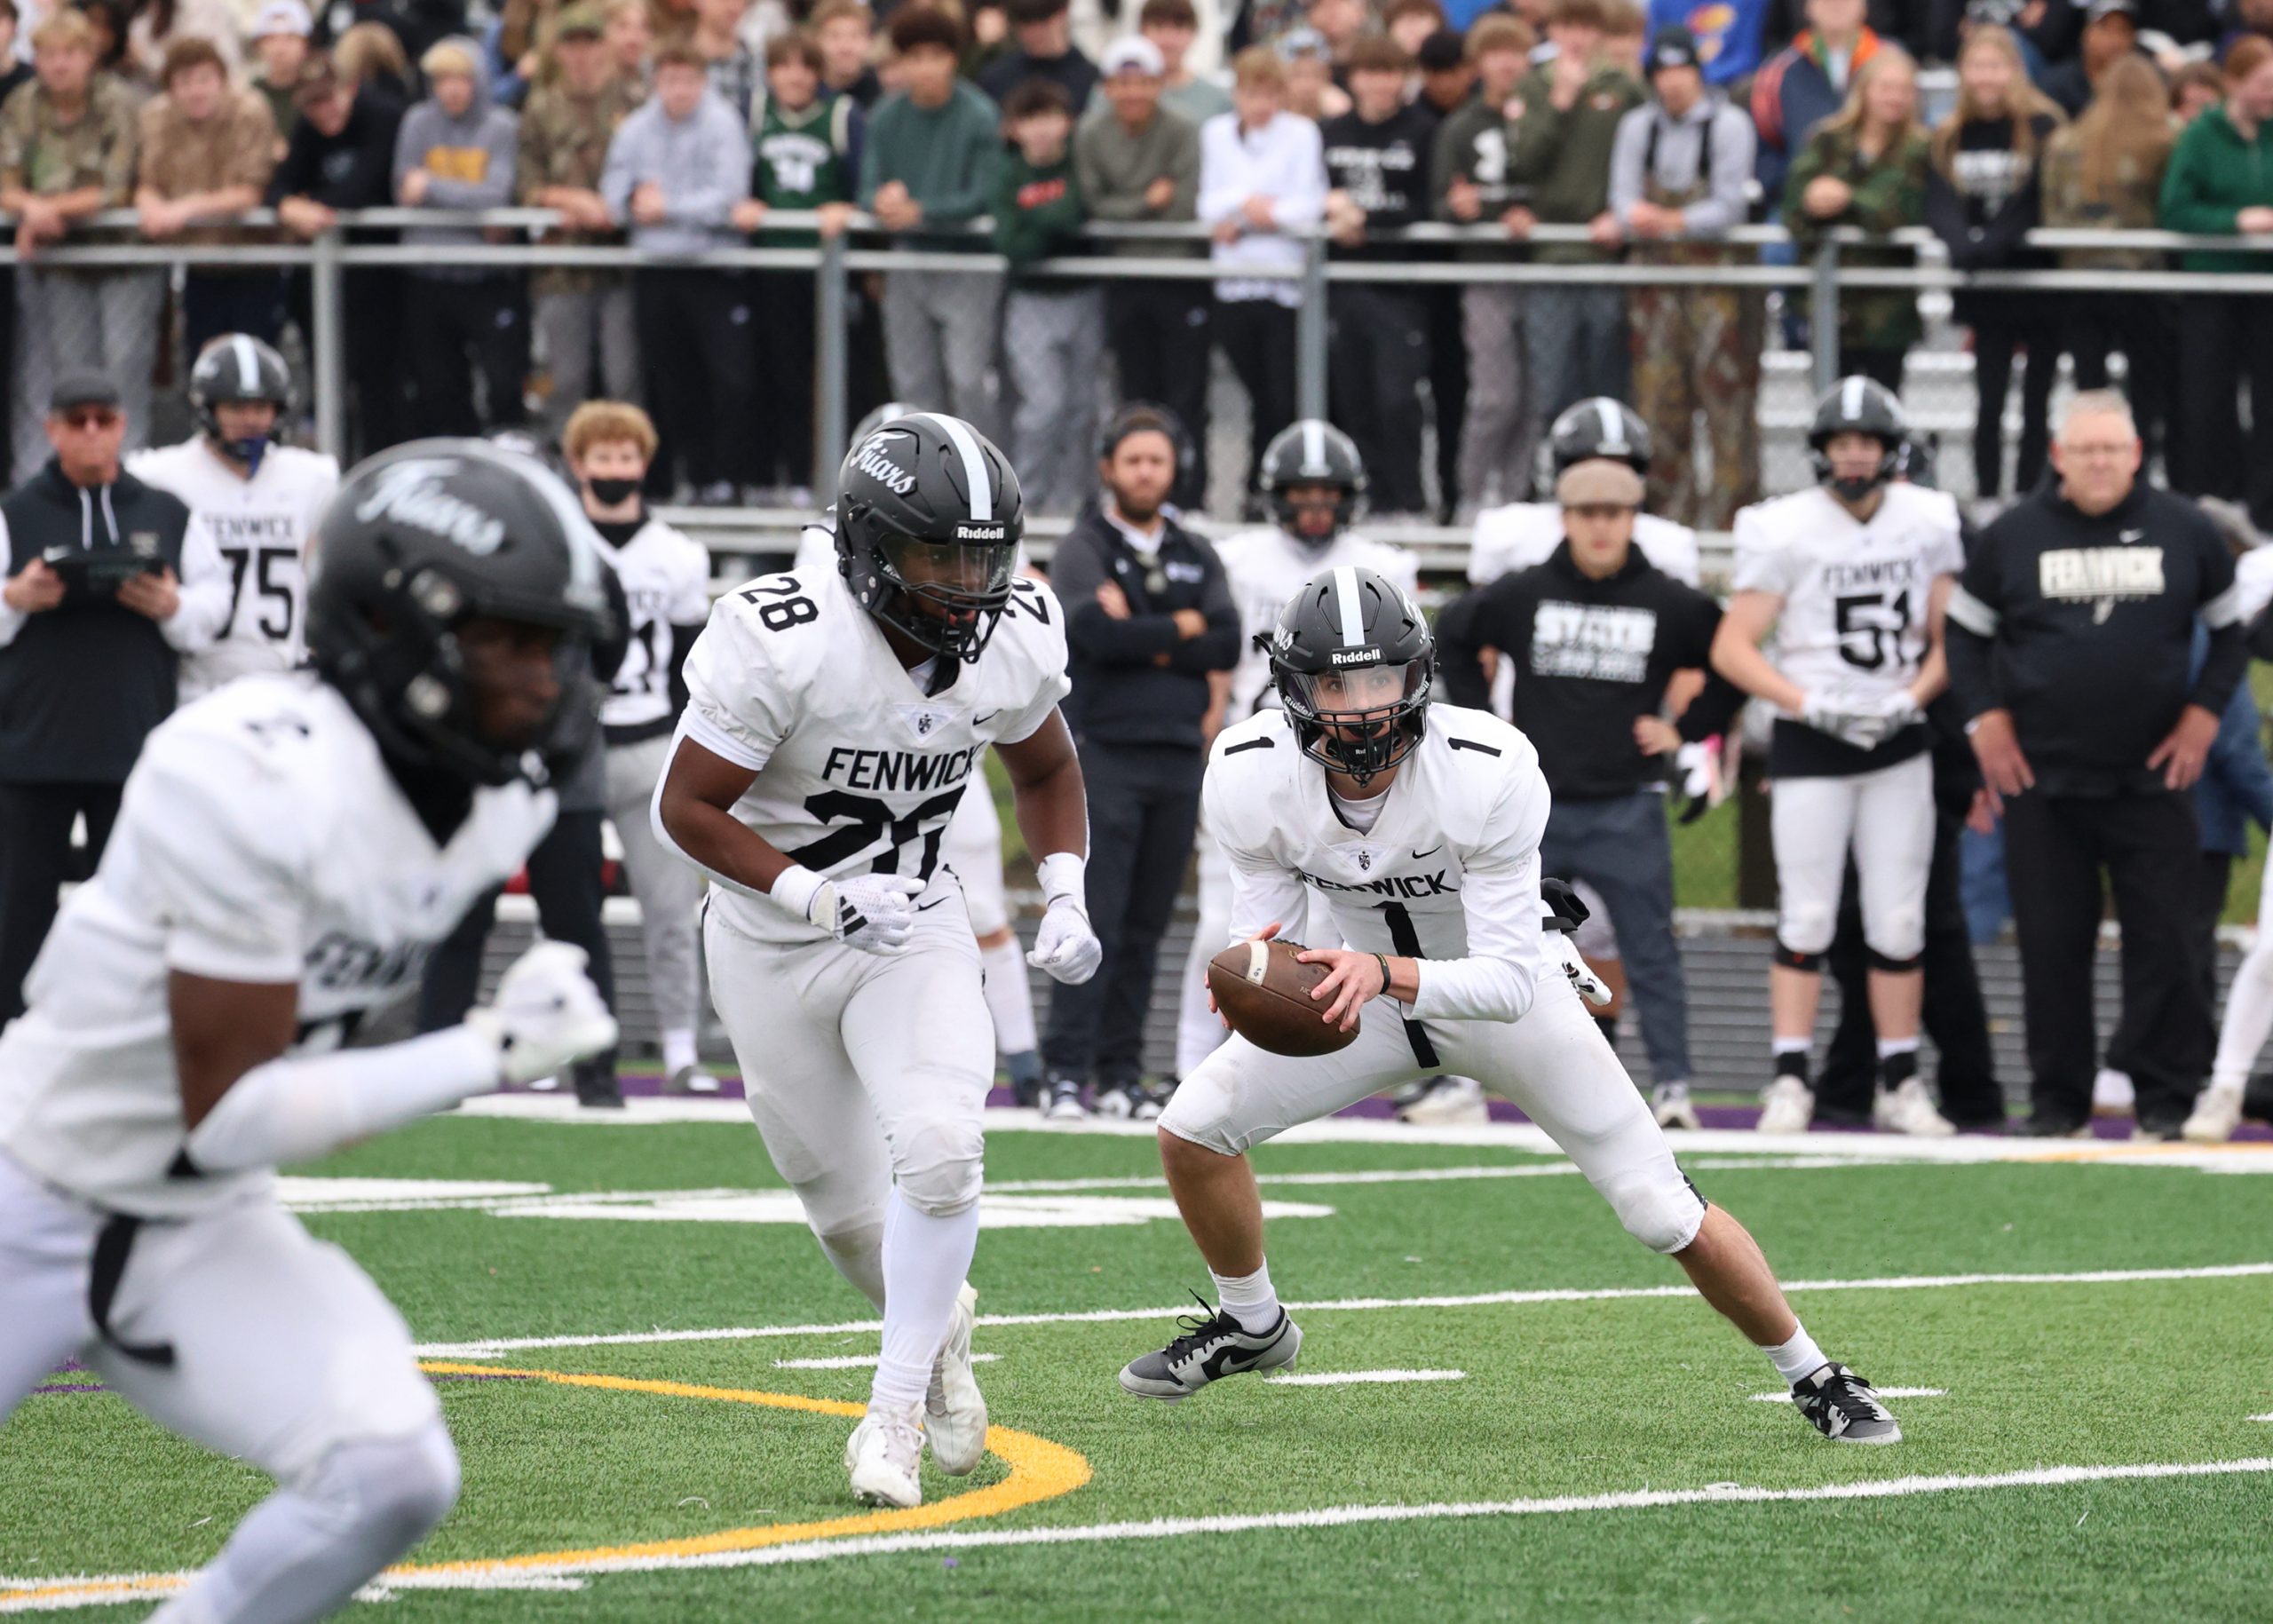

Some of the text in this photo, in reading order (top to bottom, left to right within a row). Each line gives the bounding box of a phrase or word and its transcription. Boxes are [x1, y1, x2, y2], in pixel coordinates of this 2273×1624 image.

[850, 432, 915, 494] Friars
[957, 527, 1005, 539] Riddell
[213, 547, 297, 640] 75
[738, 576, 820, 632] 28
[1333, 649, 1381, 665] Riddell
[1835, 590, 1911, 670] 51
[822, 739, 981, 791] FENWICK
[1224, 736, 1275, 757] 1
[1447, 737, 1502, 757] 1
[1372, 900, 1428, 959] 1
